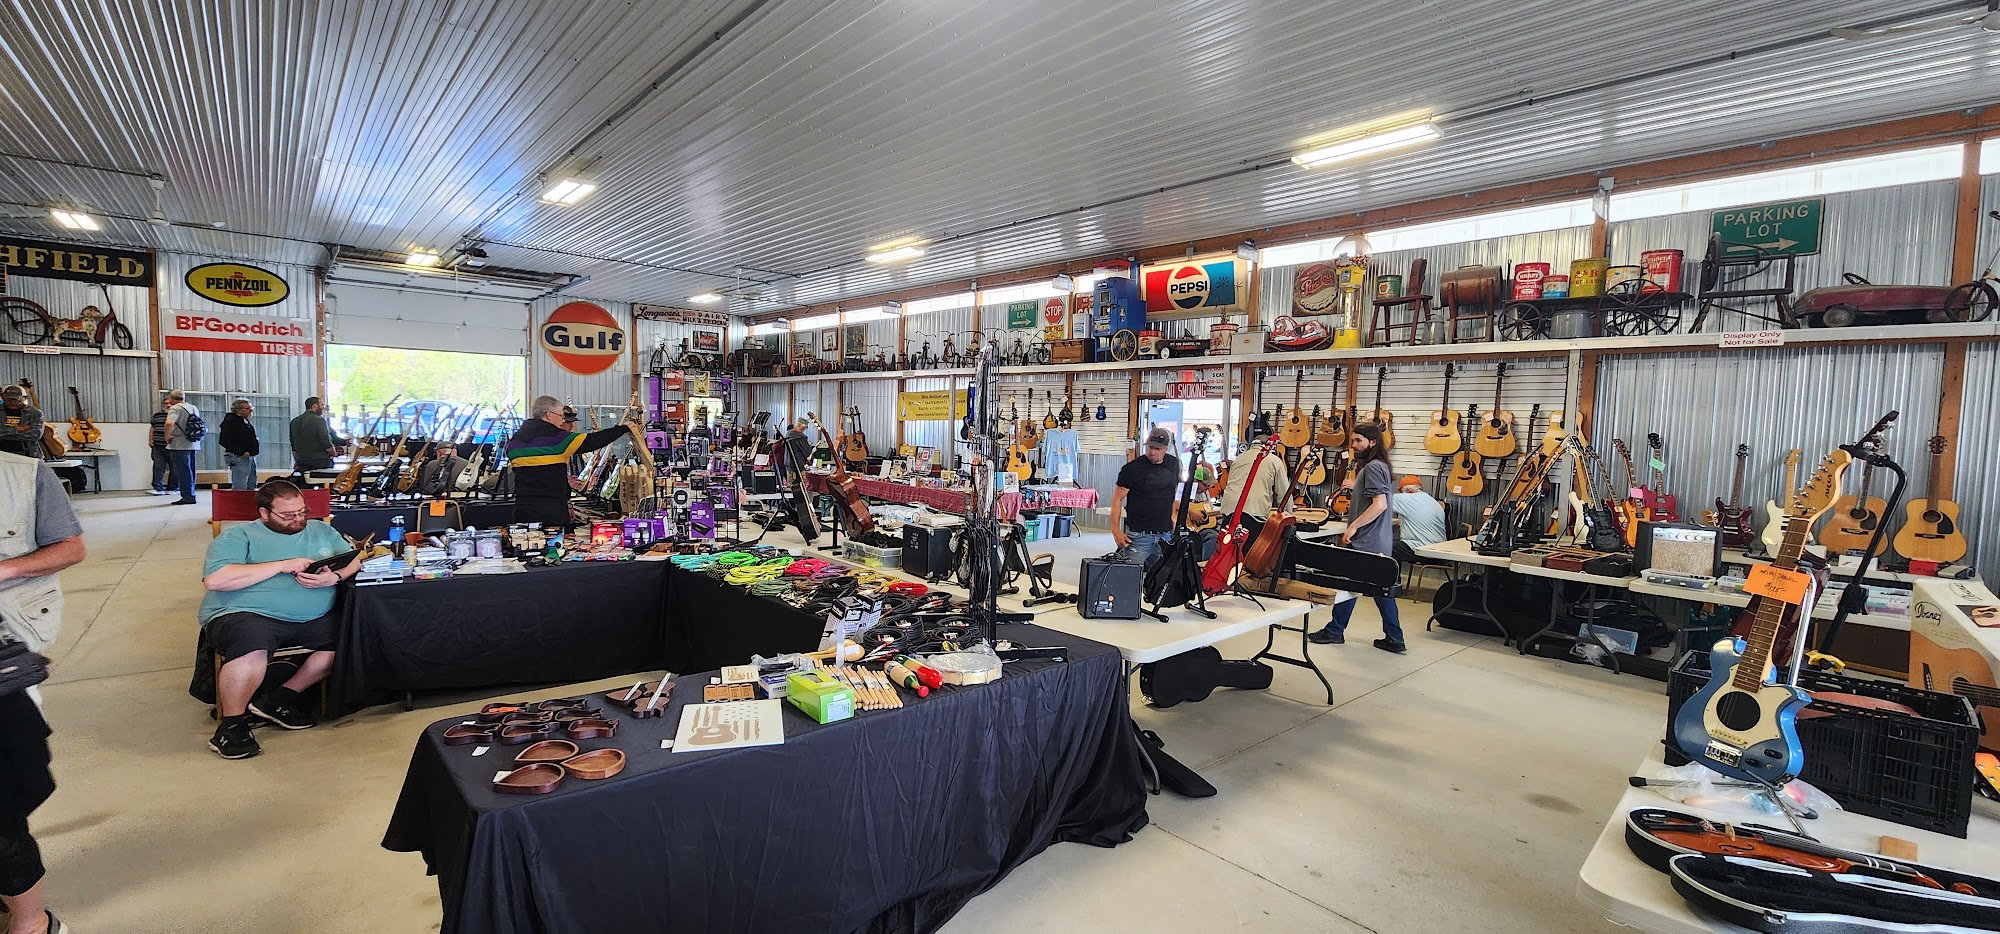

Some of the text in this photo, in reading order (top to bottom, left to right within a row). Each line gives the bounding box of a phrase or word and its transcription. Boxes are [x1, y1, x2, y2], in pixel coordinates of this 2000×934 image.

[1723, 205, 1809, 227] PARKING
[1745, 223, 1783, 238] LOT
[205, 277, 272, 292] PENNZOIL
[1170, 280, 1208, 295] PEPSI
[1010, 302, 1034, 312] PARKING
[1045, 305, 1063, 317] STOP
[1016, 311, 1028, 319] LOT
[175, 315, 303, 337] BFGoodrich
[544, 325, 623, 351] Gulf
[260, 342, 304, 355] TIRES
[1166, 383, 1207, 398] NO SMOKING
[1915, 603, 1942, 627] Ibanez
